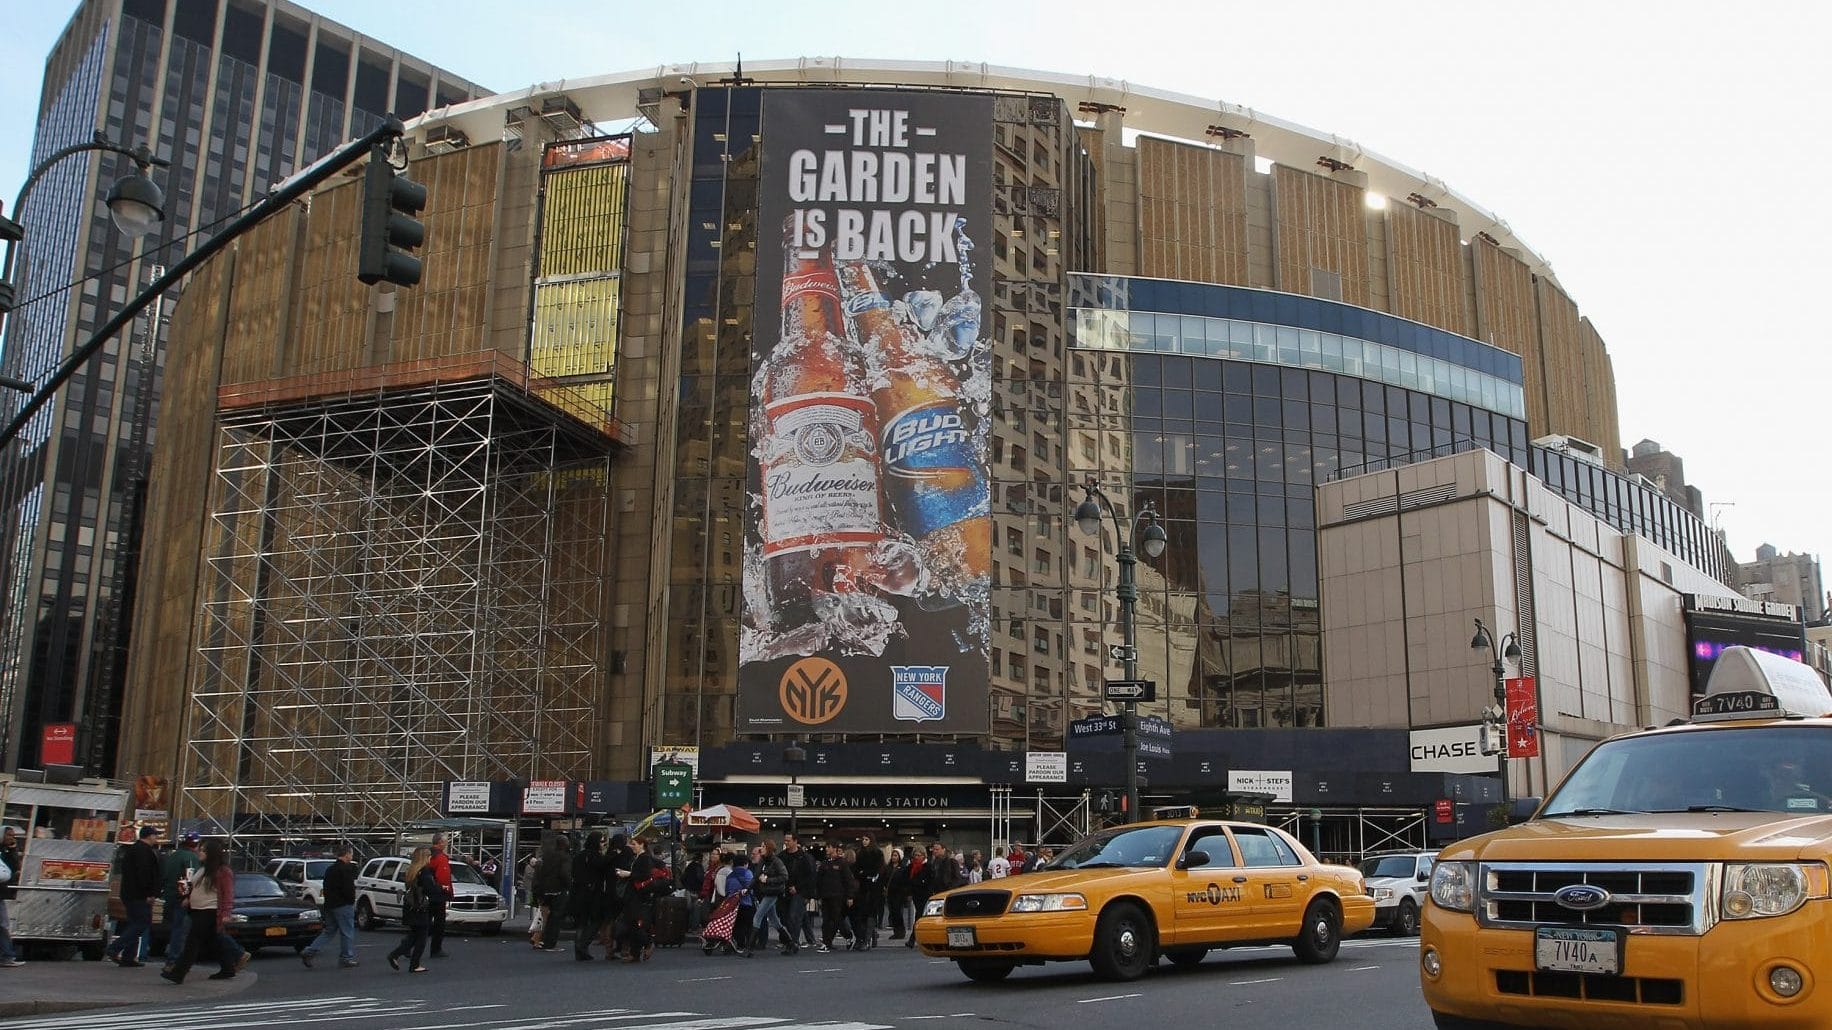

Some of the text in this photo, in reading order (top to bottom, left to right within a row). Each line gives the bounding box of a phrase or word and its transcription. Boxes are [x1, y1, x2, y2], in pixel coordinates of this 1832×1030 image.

[849, 109, 909, 147] THE
[788, 150, 967, 205] GARDEN
[793, 209, 959, 263] IS BACK
[893, 414, 962, 445] BUD
[885, 430, 968, 464] LIGHT
[767, 471, 875, 501] Budweiser
[896, 672, 942, 682] NEW YORK
[786, 667, 841, 719] NYK
[1127, 687, 1139, 695] WAY
[902, 685, 942, 717] RANGERS
[1717, 695, 1754, 712] 7V40
[1074, 720, 1117, 734] West 33rd St
[1140, 721, 1171, 736] Eighth Ave
[1140, 742, 1149, 751] Joe
[1411, 742, 1477, 760] CHASE
[660, 769, 688, 778] Subway
[886, 797, 949, 807] STATION
[995, 863, 1002, 874] 2
[1186, 891, 1208, 904] NYC
[1567, 890, 1593, 903] Ford
